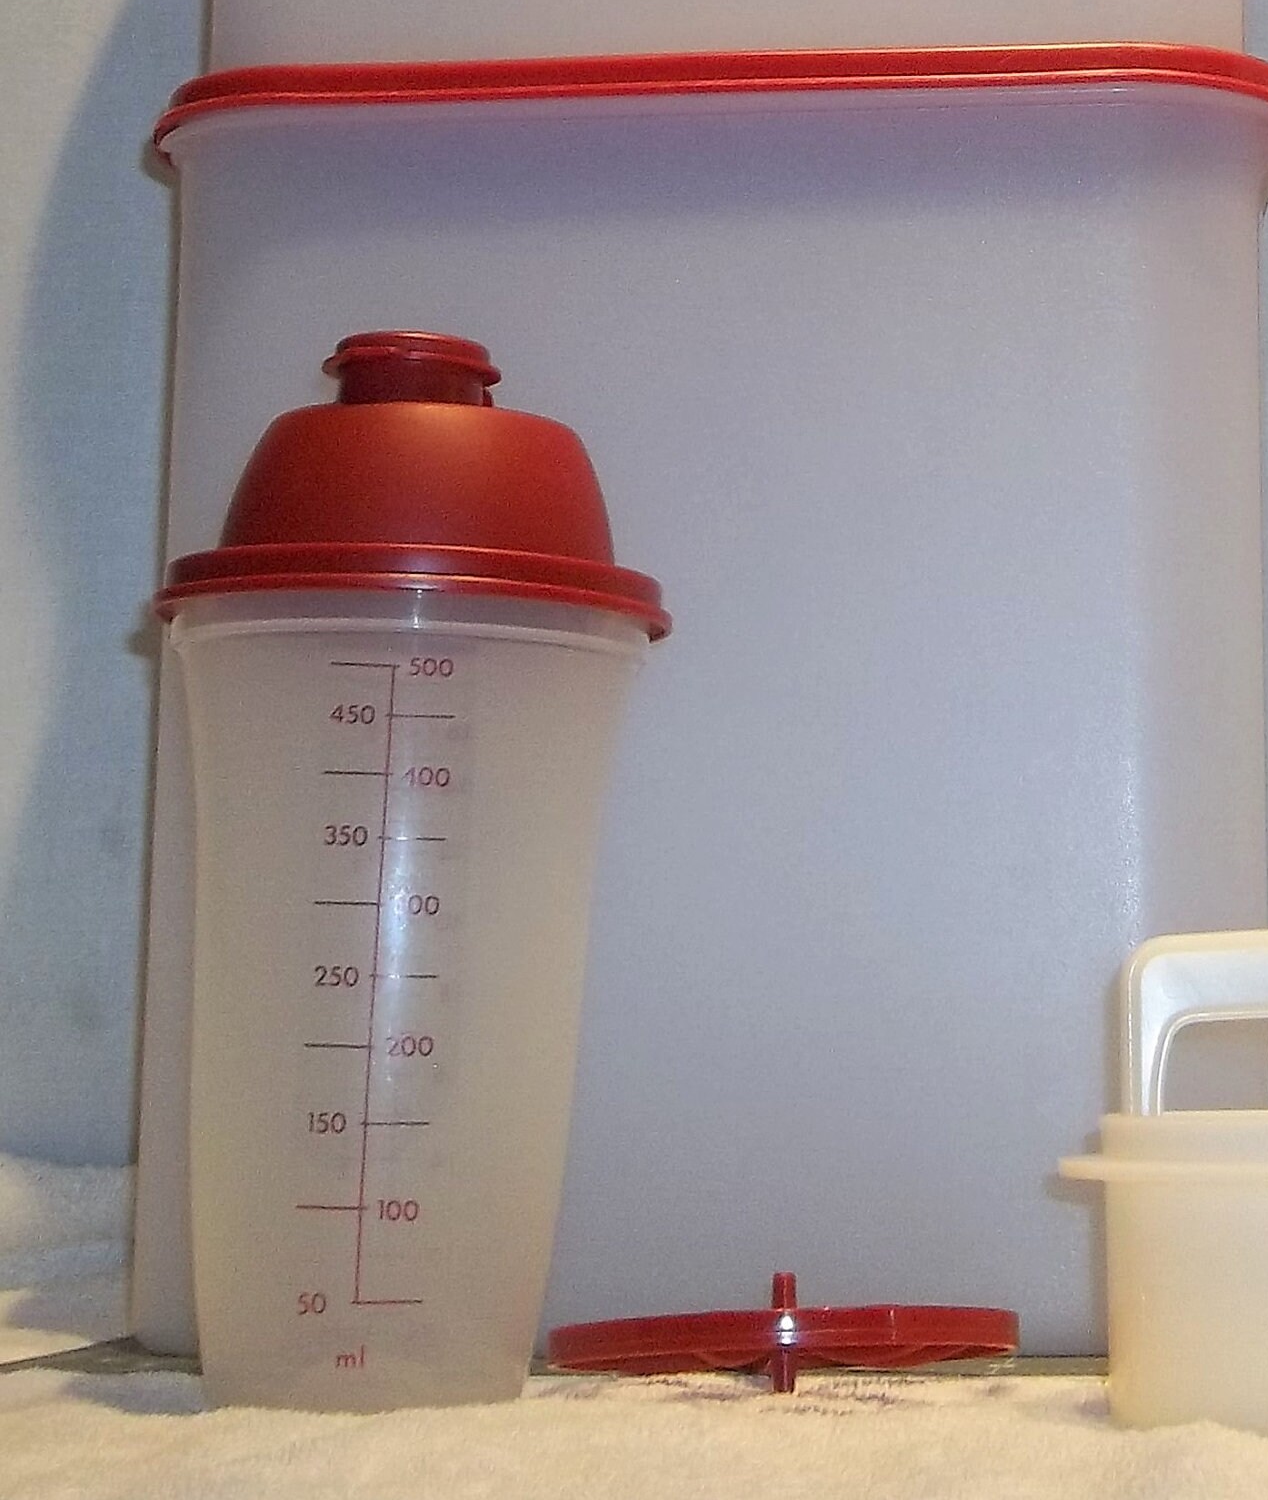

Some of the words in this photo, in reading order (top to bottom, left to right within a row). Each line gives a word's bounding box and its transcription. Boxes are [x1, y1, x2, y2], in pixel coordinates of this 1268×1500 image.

[409, 658, 454, 677] 500
[329, 705, 376, 725] 450
[323, 825, 368, 846] 350
[314, 966, 359, 987] 250
[386, 1036, 433, 1057] 200
[307, 1112, 346, 1134] 150
[377, 1200, 420, 1222] 100
[297, 1293, 326, 1315] 50
[335, 1346, 366, 1368] ml
